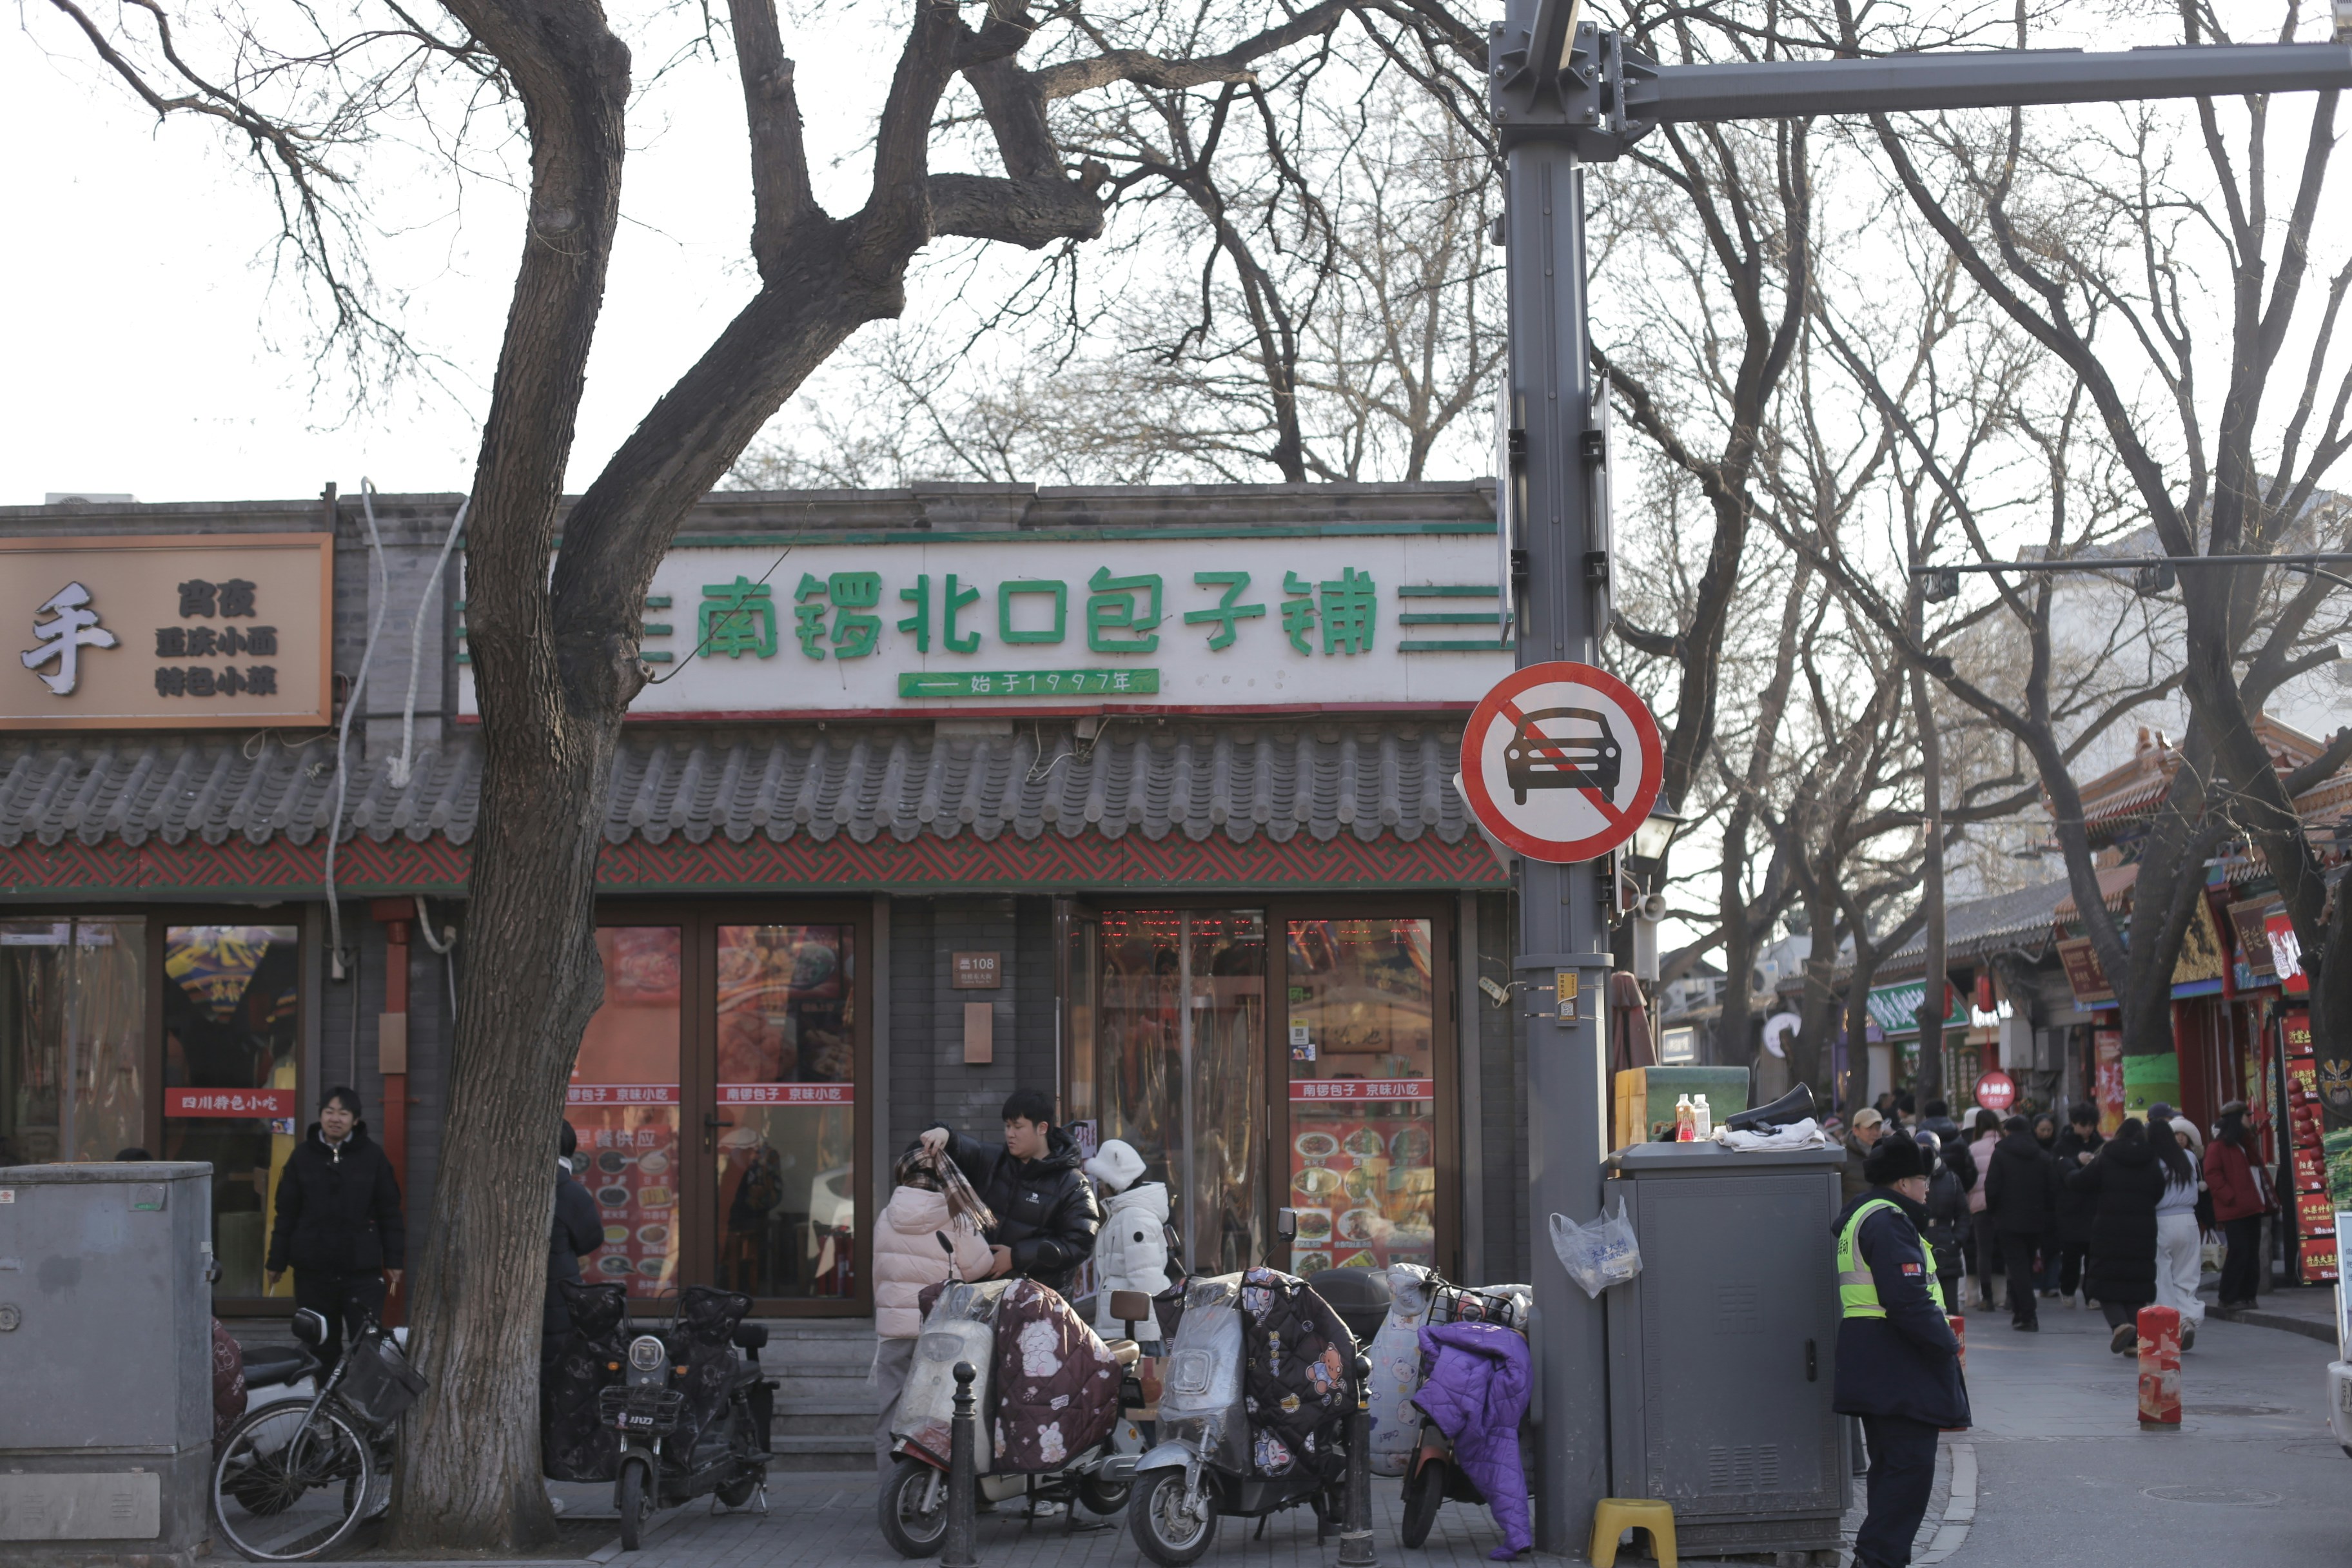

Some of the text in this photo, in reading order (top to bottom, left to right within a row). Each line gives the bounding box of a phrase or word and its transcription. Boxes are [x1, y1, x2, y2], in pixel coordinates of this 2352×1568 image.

[177, 578, 257, 618] 宵夜
[698, 565, 1377, 660] 南锣北口包子铺
[20, 581, 121, 696] 手
[155, 626, 278, 658] 重庆小面
[155, 665, 278, 697] 特色小菜
[972, 958, 994, 970] 108
[567, 1088, 669, 1102] 锣包子 京味小吃
[726, 1088, 841, 1101] 南锣包子 京味小吃
[1303, 1083, 1418, 1097] 南锣包子 京味小吃
[182, 1095, 279, 1111] 四川特色小吃
